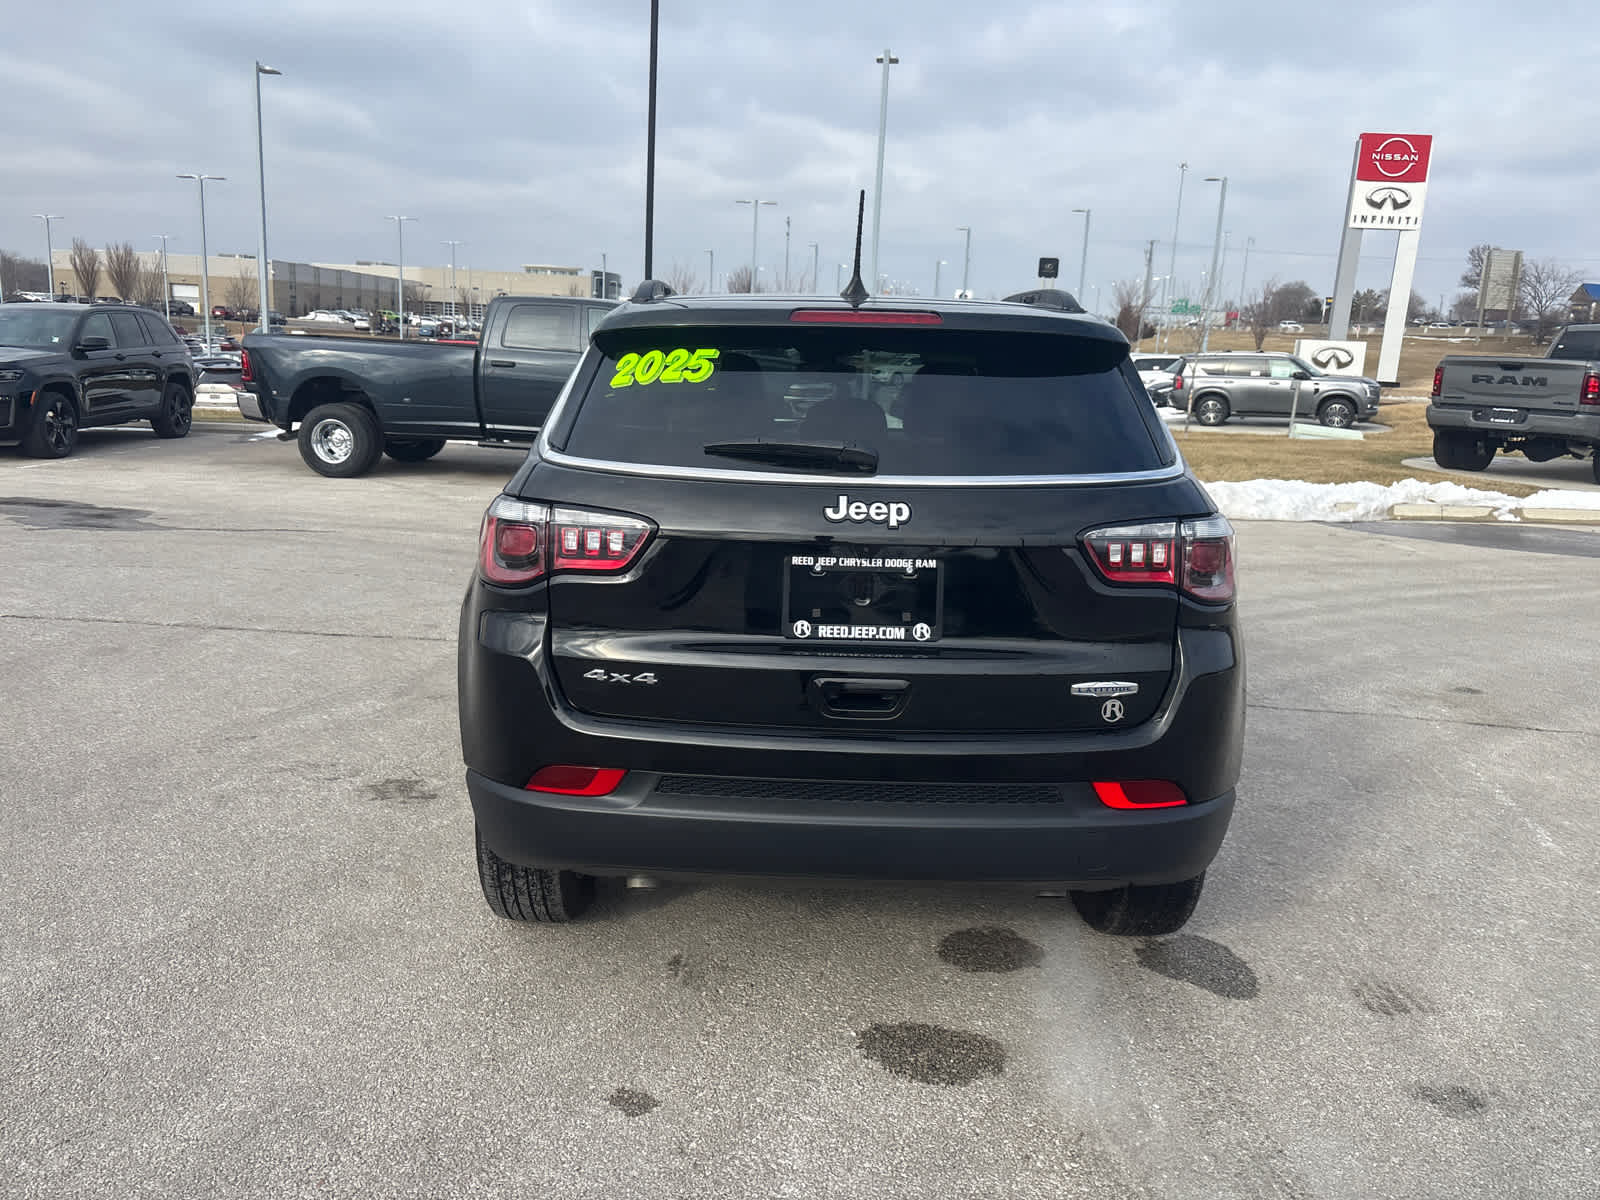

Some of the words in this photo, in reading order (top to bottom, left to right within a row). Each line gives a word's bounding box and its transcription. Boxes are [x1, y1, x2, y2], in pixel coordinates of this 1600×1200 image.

[1371, 153, 1419, 161] NISSAN
[1353, 215, 1418, 225] INFINITI
[609, 348, 720, 388] 2025
[1471, 374, 1548, 387] RAM
[824, 495, 911, 528] Jeep
[791, 556, 814, 566] REED
[815, 556, 837, 567] JEEP
[838, 557, 883, 568] CHRYSLER
[884, 558, 913, 568] DODGE
[915, 559, 937, 569] RAM
[818, 625, 905, 640] REEDJEEP.COM
